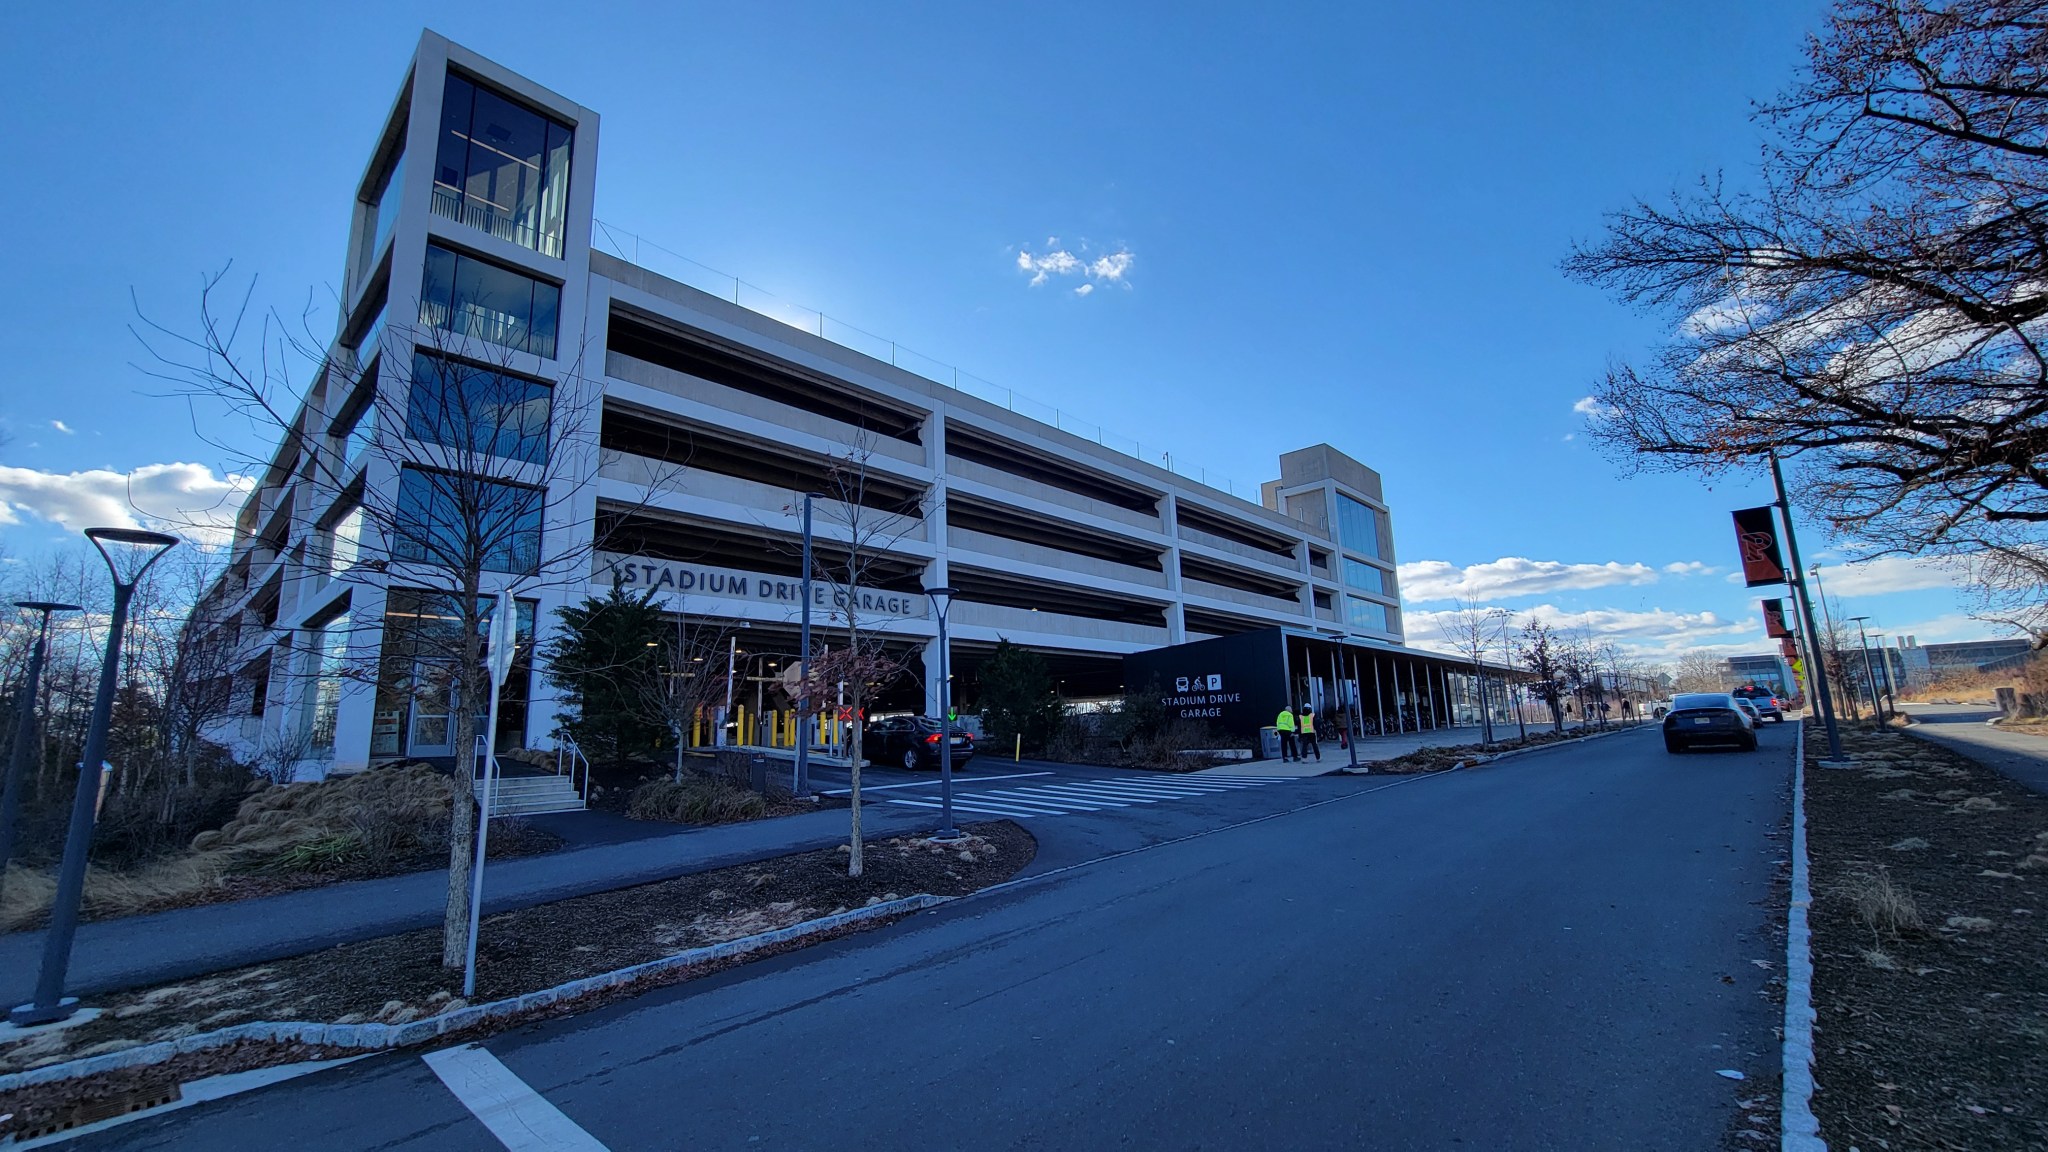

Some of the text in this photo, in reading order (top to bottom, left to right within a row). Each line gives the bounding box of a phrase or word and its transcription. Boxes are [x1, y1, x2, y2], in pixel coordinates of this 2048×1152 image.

[624, 563, 747, 595] STADIUM
[1161, 693, 1241, 706] STADIUM DRIVE
[1180, 708, 1222, 718] GARAGE
